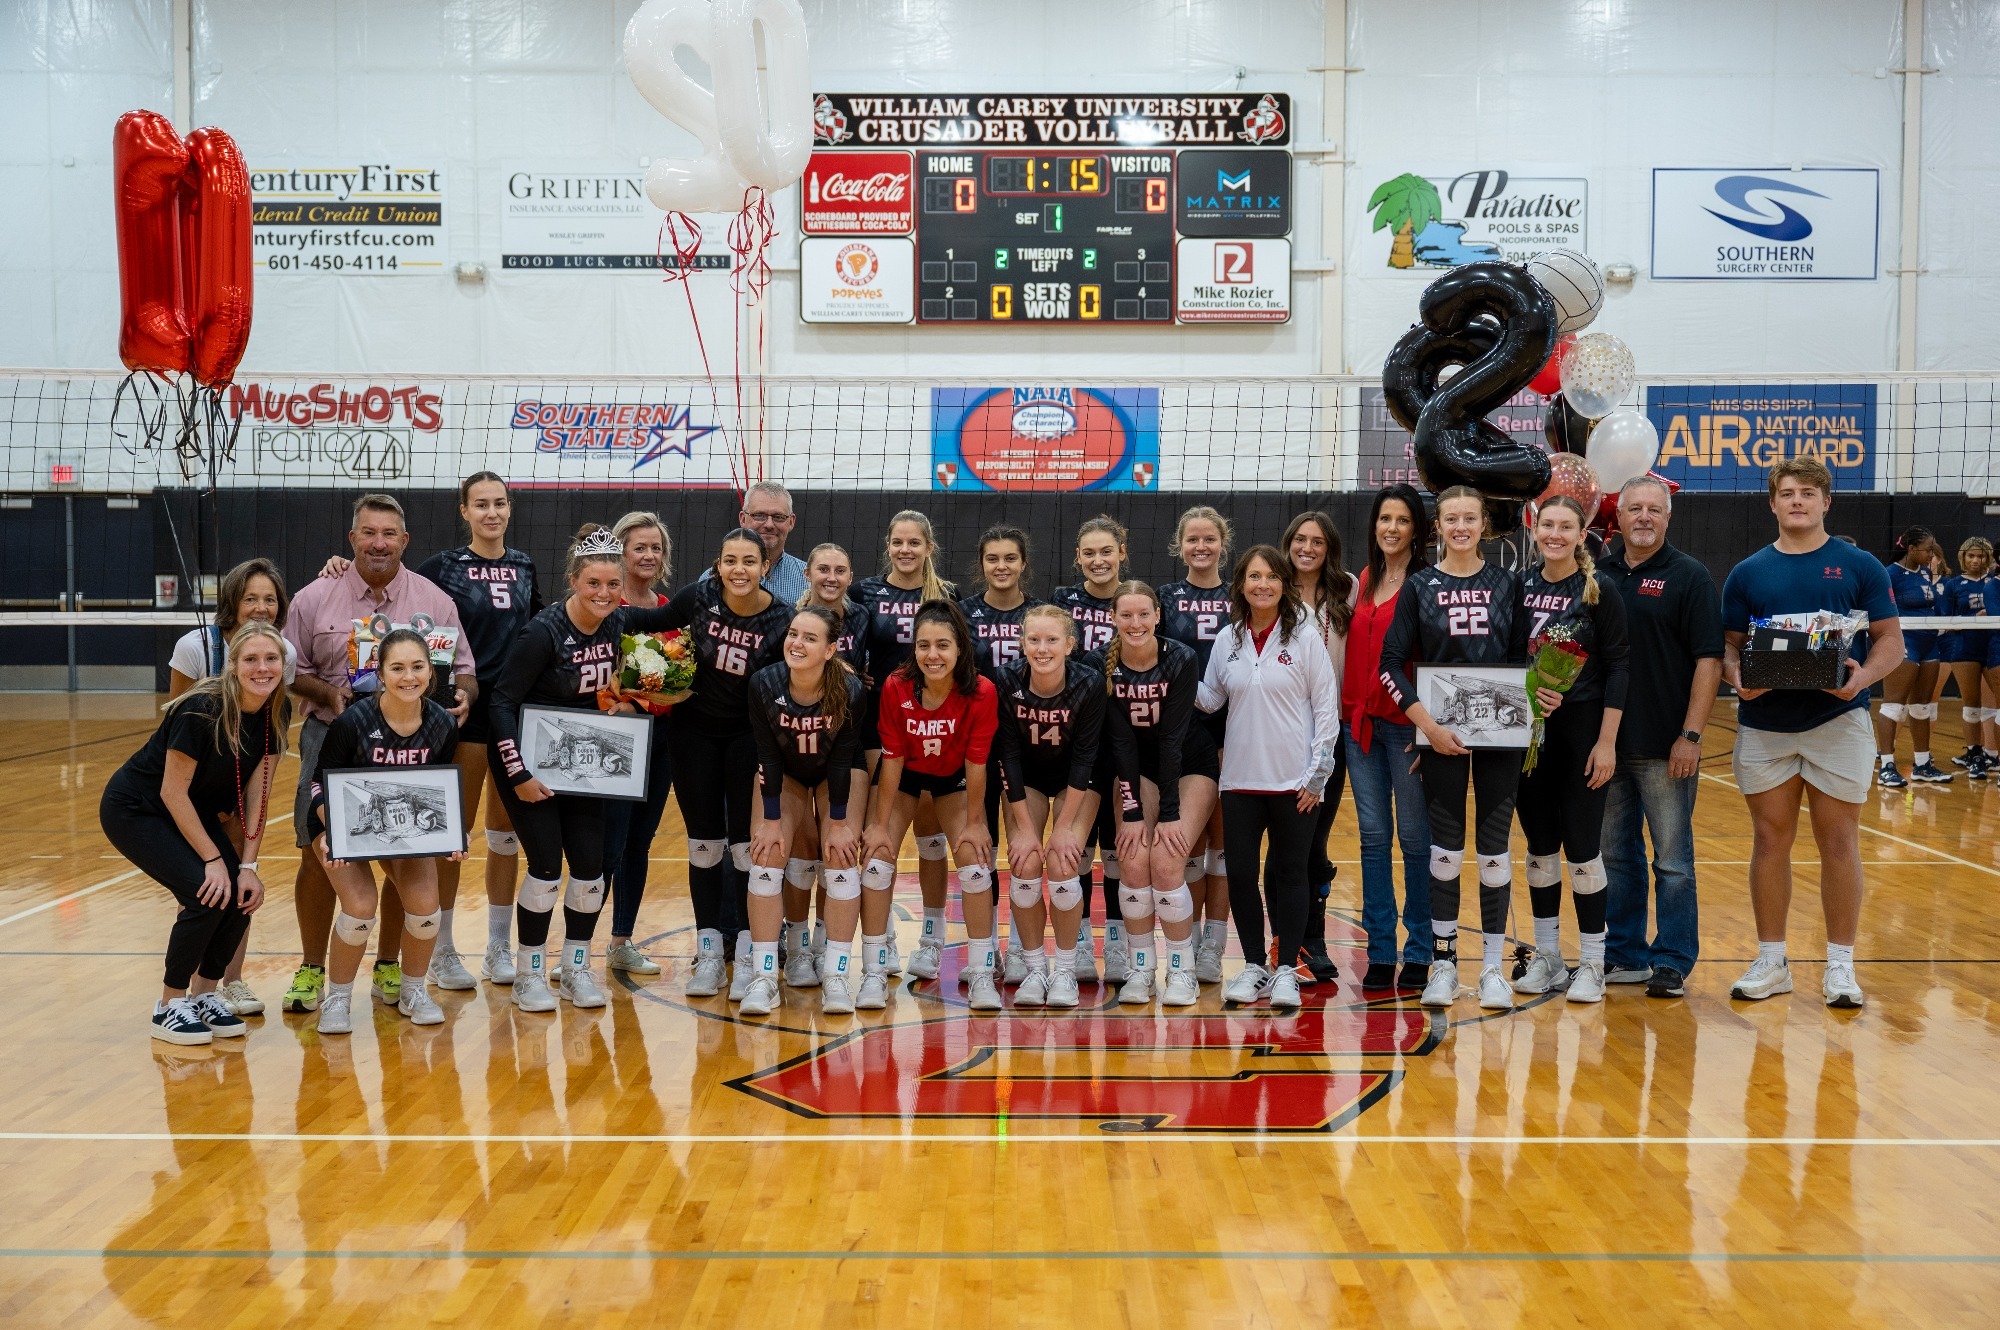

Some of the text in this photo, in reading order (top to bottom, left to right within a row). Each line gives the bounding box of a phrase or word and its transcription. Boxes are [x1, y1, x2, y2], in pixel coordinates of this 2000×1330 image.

[848, 98, 1244, 117] WILLIAM CAREY UNIVERSITY
[858, 119, 1234, 143] CRUSADER VOLLEYBALL
[928, 157, 973, 173] HOME
[1111, 156, 1171, 173] VISITOR
[250, 165, 441, 201] enturyFirst
[508, 172, 643, 199] GRIFFIN
[822, 172, 910, 202] Coca-Cola
[955, 179, 976, 212] 0
[1146, 179, 1167, 212] 0
[1187, 196, 1281, 209] MATRIX
[1448, 170, 1582, 218] Paradise
[253, 206, 439, 222] deral Credit Union
[509, 205, 643, 214] INSURANCE ASSOCIATES, LLC
[804, 212, 911, 221] SCOREBOARD PROVIDED BY
[1015, 205, 1062, 231] SET 1
[807, 221, 908, 230] HATTIESBURG COCA-COLA
[1488, 223, 1579, 233] POOLS & SPAS
[254, 229, 435, 250] nturyfirstfcu.com
[1500, 236, 1568, 244] INCORPORATED
[268, 255, 398, 270] 601-450-4114
[508, 256, 554, 267] GOOD
[564, 256, 613, 268] LUCK,
[946, 249, 953, 260] 1
[996, 250, 1008, 268] 2
[1017, 248, 1073, 260] TIMEOUTS
[1084, 250, 1095, 268] 2
[1138, 249, 1146, 260] 3
[1717, 247, 1814, 261] SOUTHERN
[1031, 260, 1058, 272] LEFT
[1717, 263, 1813, 273] SURGERY CENTER
[945, 287, 954, 298] 2
[1023, 283, 1071, 300] SETS
[1138, 287, 1146, 298] 4
[1193, 287, 1274, 299] Mike Rozier
[992, 285, 1012, 318] 0
[1024, 301, 1070, 319] WON
[1080, 285, 1100, 318] 0
[1182, 300, 1245, 308] Construction
[1266, 300, 1285, 308] Inc.
[1014, 387, 1074, 407] NAIA
[1710, 399, 1813, 411] MISSISSIPPI
[511, 399, 677, 428] SOUTHERN
[1497, 415, 1545, 431] Rent
[537, 427, 651, 451] STATES
[1656, 415, 1863, 467] AIR NATIONAL
[557, 452, 638, 460] Athletic Conference
[1751, 438, 1865, 468] GUARD
[52, 465, 73, 483] EXIT
[467, 567, 517, 580] CAREY
[1641, 578, 1666, 590] WCU
[489, 582, 511, 609] 5
[1437, 590, 1492, 605] CAREY
[1523, 594, 1572, 611] CAREY
[1072, 606, 1114, 624] CARE
[1178, 600, 1233, 612] CAREY
[1197, 614, 1218, 640] 2
[1448, 606, 1489, 636] 22
[1529, 611, 1551, 639] 7
[707, 620, 764, 649] CAREY
[896, 617, 915, 644] 3
[978, 624, 1021, 638] CARE
[1083, 625, 1114, 651] 13
[715, 643, 748, 676] 16
[990, 640, 1020, 668] 15
[578, 661, 614, 694] 20
[1115, 682, 1169, 699] CAREY
[779, 712, 834, 731] CAREY
[1016, 704, 1071, 723] CAREY
[1129, 701, 1161, 727] 21
[1473, 707, 1489, 719] 22
[906, 718, 956, 736] CAREY
[1028, 723, 1061, 746] 14
[796, 732, 818, 754] 11
[372, 747, 430, 765] CAREY
[579, 753, 594, 765] 20
[392, 812, 406, 826] 10
